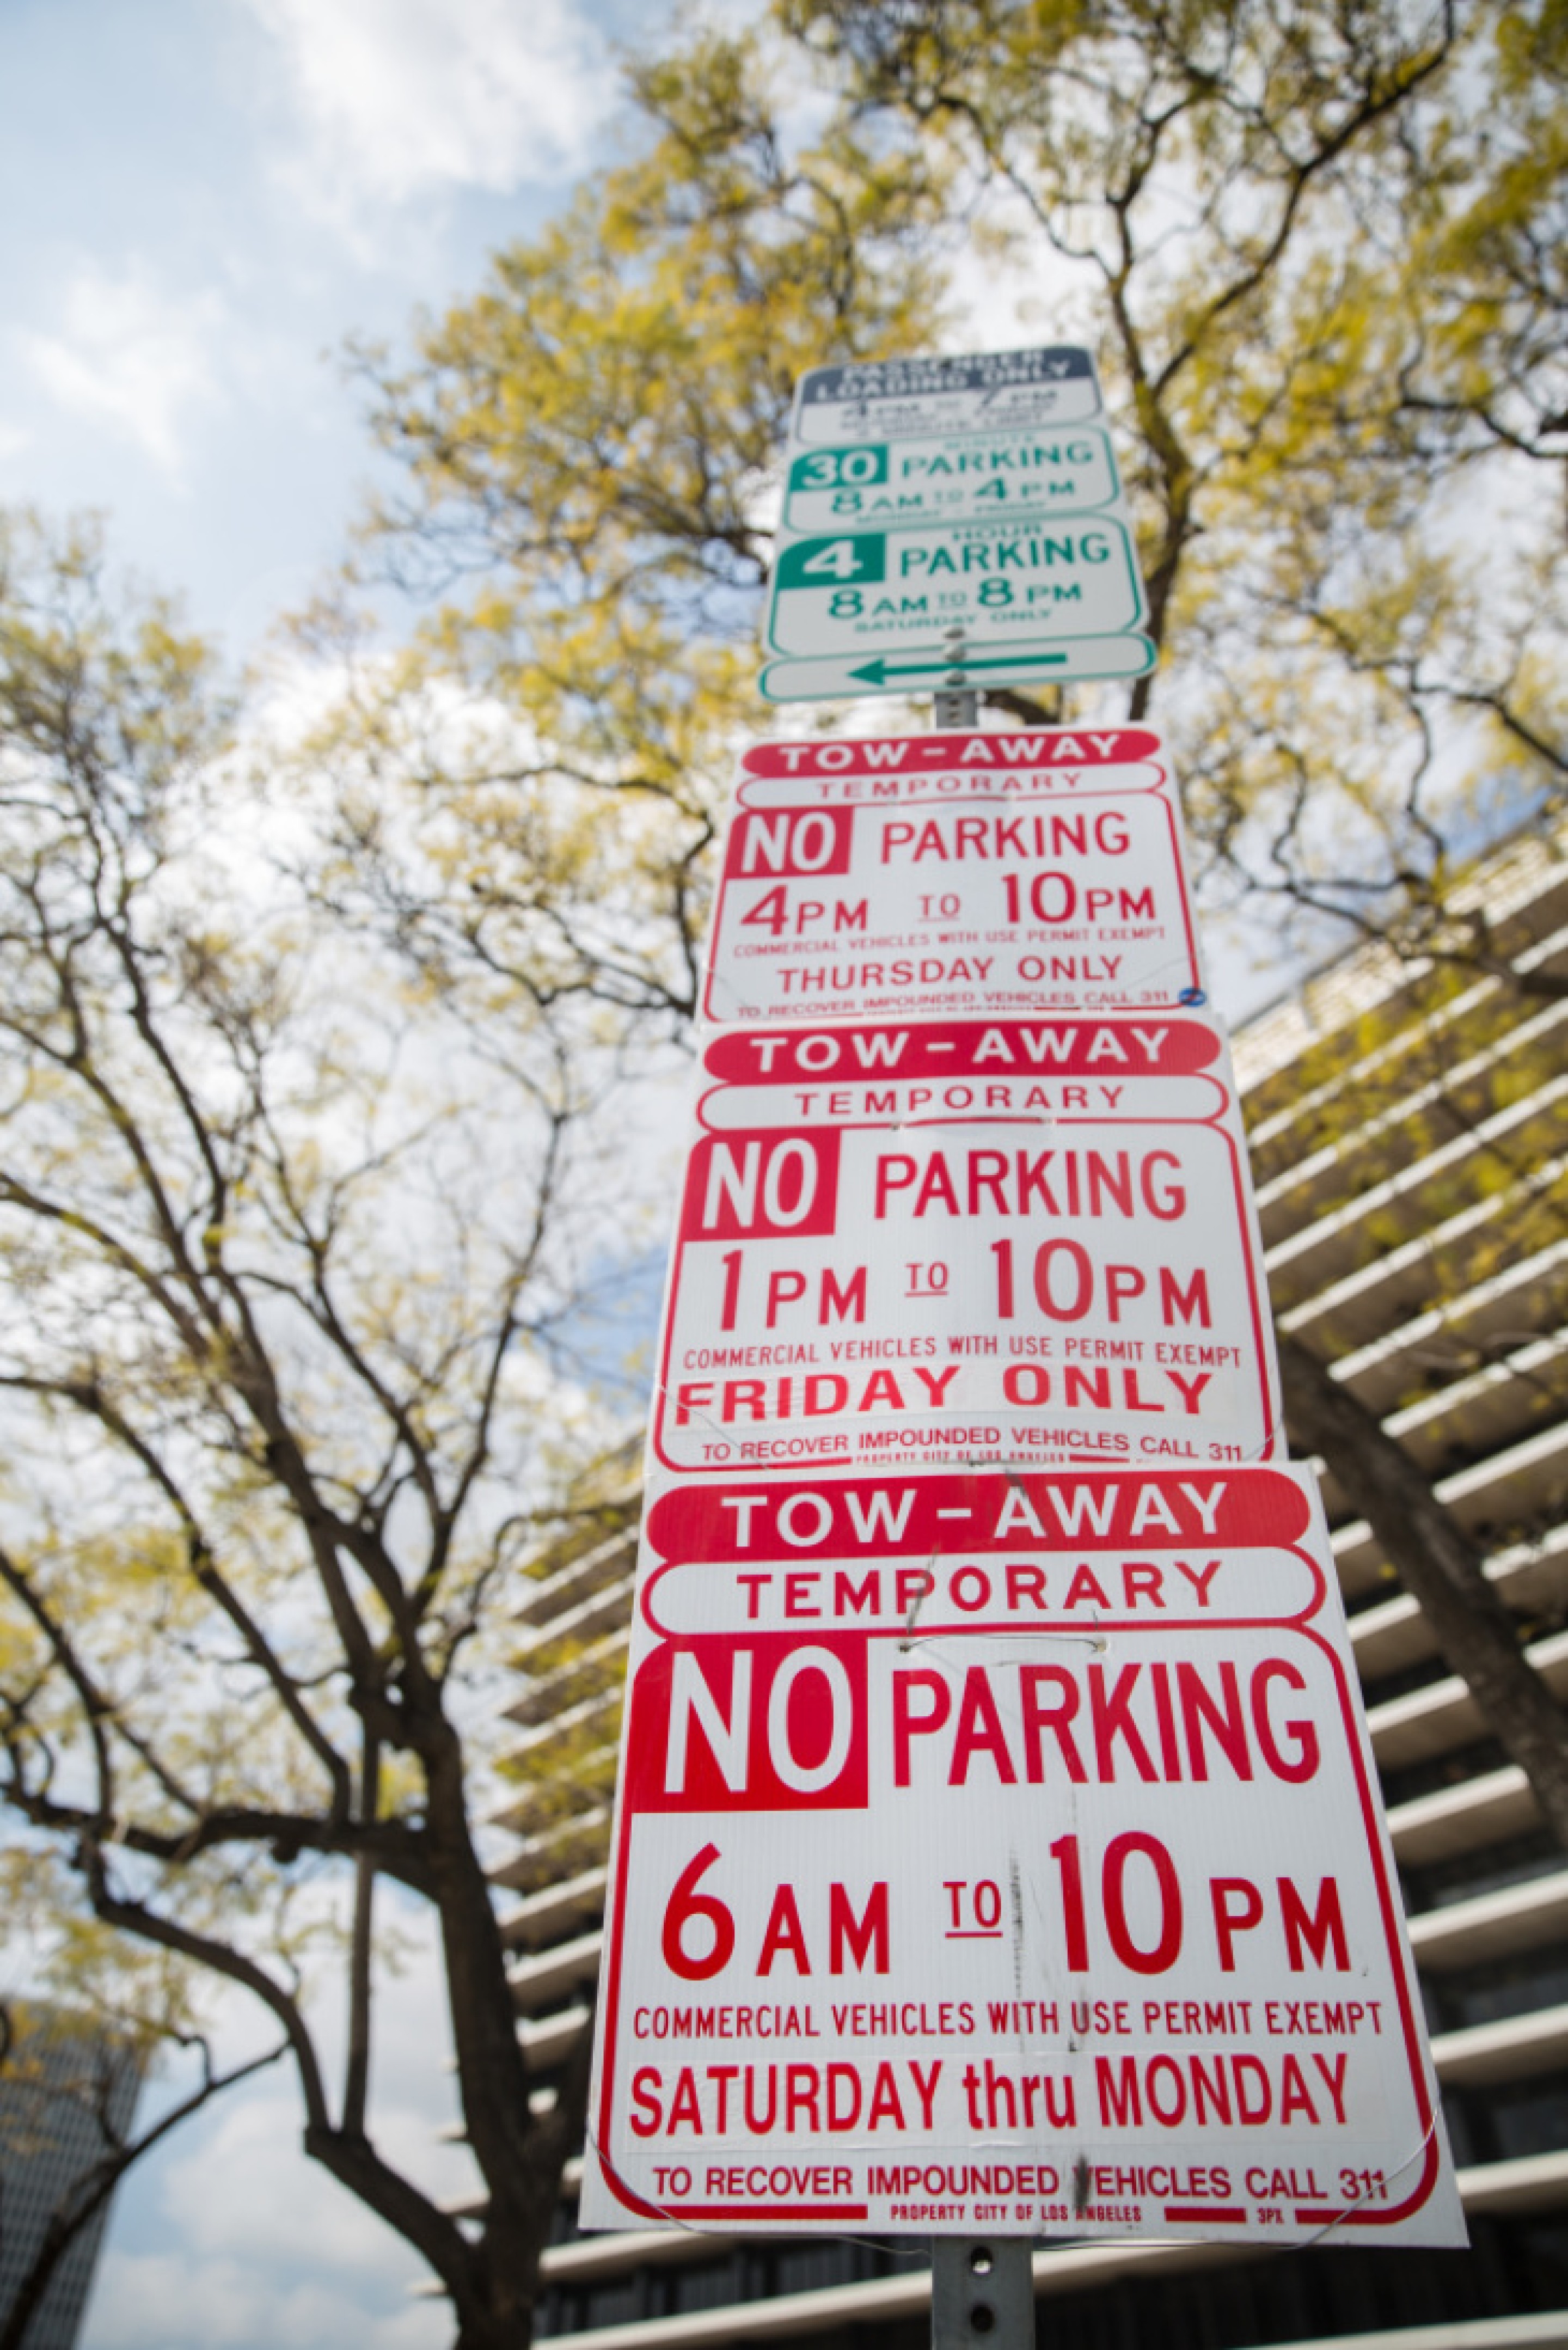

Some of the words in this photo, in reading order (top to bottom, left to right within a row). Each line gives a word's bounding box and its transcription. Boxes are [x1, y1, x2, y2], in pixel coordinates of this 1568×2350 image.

[802, 450, 880, 486] 30
[902, 442, 1094, 478] PARKING
[832, 489, 863, 515] 8
[873, 493, 923, 512] AM
[973, 477, 1006, 500] 4
[1020, 479, 1075, 498] PM
[952, 524, 1044, 543] HOUR
[803, 541, 863, 578] 4
[901, 534, 1110, 577] PARKING
[828, 590, 865, 620] 8
[874, 594, 929, 614] AM
[978, 577, 1014, 608] 8
[1027, 583, 1082, 602] PM
[854, 614, 976, 633] SATURDAY
[991, 608, 1052, 623] ONLY
[817, 773, 1083, 799] TEMPORARY
[741, 811, 835, 873] NO
[880, 812, 1130, 864] PARKING
[920, 895, 961, 916] TO
[734, 940, 837, 958] COMMERCIAL
[848, 933, 930, 950] VEHICLES
[939, 931, 978, 944] WITH
[985, 930, 1017, 943] USE
[1027, 927, 1089, 943] PERMIT
[1098, 927, 1165, 941] EXEMPT
[777, 954, 994, 994] THURSDAY
[1018, 953, 1123, 982] ONLY
[738, 1005, 761, 1019] TO
[768, 999, 855, 1016] RECOVER
[863, 992, 975, 1009] IMPOUNDED
[983, 990, 1075, 1004] VEHICLES
[1083, 990, 1132, 1004] CALL
[1140, 989, 1169, 1002] 311
[795, 1085, 1125, 1116] TEMPORARY
[701, 1137, 819, 1231] NO
[873, 1148, 1187, 1221] PARKING
[905, 1262, 949, 1292] TO
[684, 1344, 820, 1370] COMMERCIAL
[830, 1337, 938, 1362] VEHICLES
[948, 1335, 999, 1357] WITH
[1009, 1336, 1053, 1357] USE
[1065, 1337, 1144, 1362] PERMIT
[1155, 1343, 1242, 1369] EXEMPT
[674, 1365, 961, 1427] FRIDAY
[1002, 1363, 1213, 1416] ONLY
[701, 1443, 731, 1461] TO
[740, 1433, 849, 1460] RECOVER
[859, 1427, 1001, 1449] IMPOUNDED
[1011, 1426, 1130, 1451] VEHICLES
[1140, 1435, 1199, 1459] CALL
[1208, 1442, 1243, 1461] 311
[737, 1560, 1222, 1619] TEMPORARY
[663, 1645, 854, 1794] NO
[893, 1657, 1320, 1788] PARKING
[942, 1880, 1002, 1927] TO
[634, 2004, 818, 2039] COMMERCIAL
[832, 2002, 975, 2035] VEHICLES
[989, 2002, 1059, 2035] WITH
[1070, 2002, 1133, 2035] USE
[1144, 2001, 1253, 2034] PERMIT
[1266, 2001, 1383, 2035] EXEMPT
[630, 2059, 944, 2137] SATURDAY
[963, 2059, 1077, 2130] thru
[1096, 2053, 1348, 2128] MONDAY
[653, 2167, 693, 2196] TO
[705, 2167, 853, 2196] RECOVER
[867, 2165, 1059, 2196] IMPOUNDED
[1245, 2167, 1328, 2199] CALL
[1339, 2168, 1388, 2199] 311
[890, 2204, 965, 2220] PROPERTY
[973, 2204, 1007, 2221] CITY
[1014, 2204, 1033, 2221] OF
[1041, 2204, 1068, 2221] LOS
